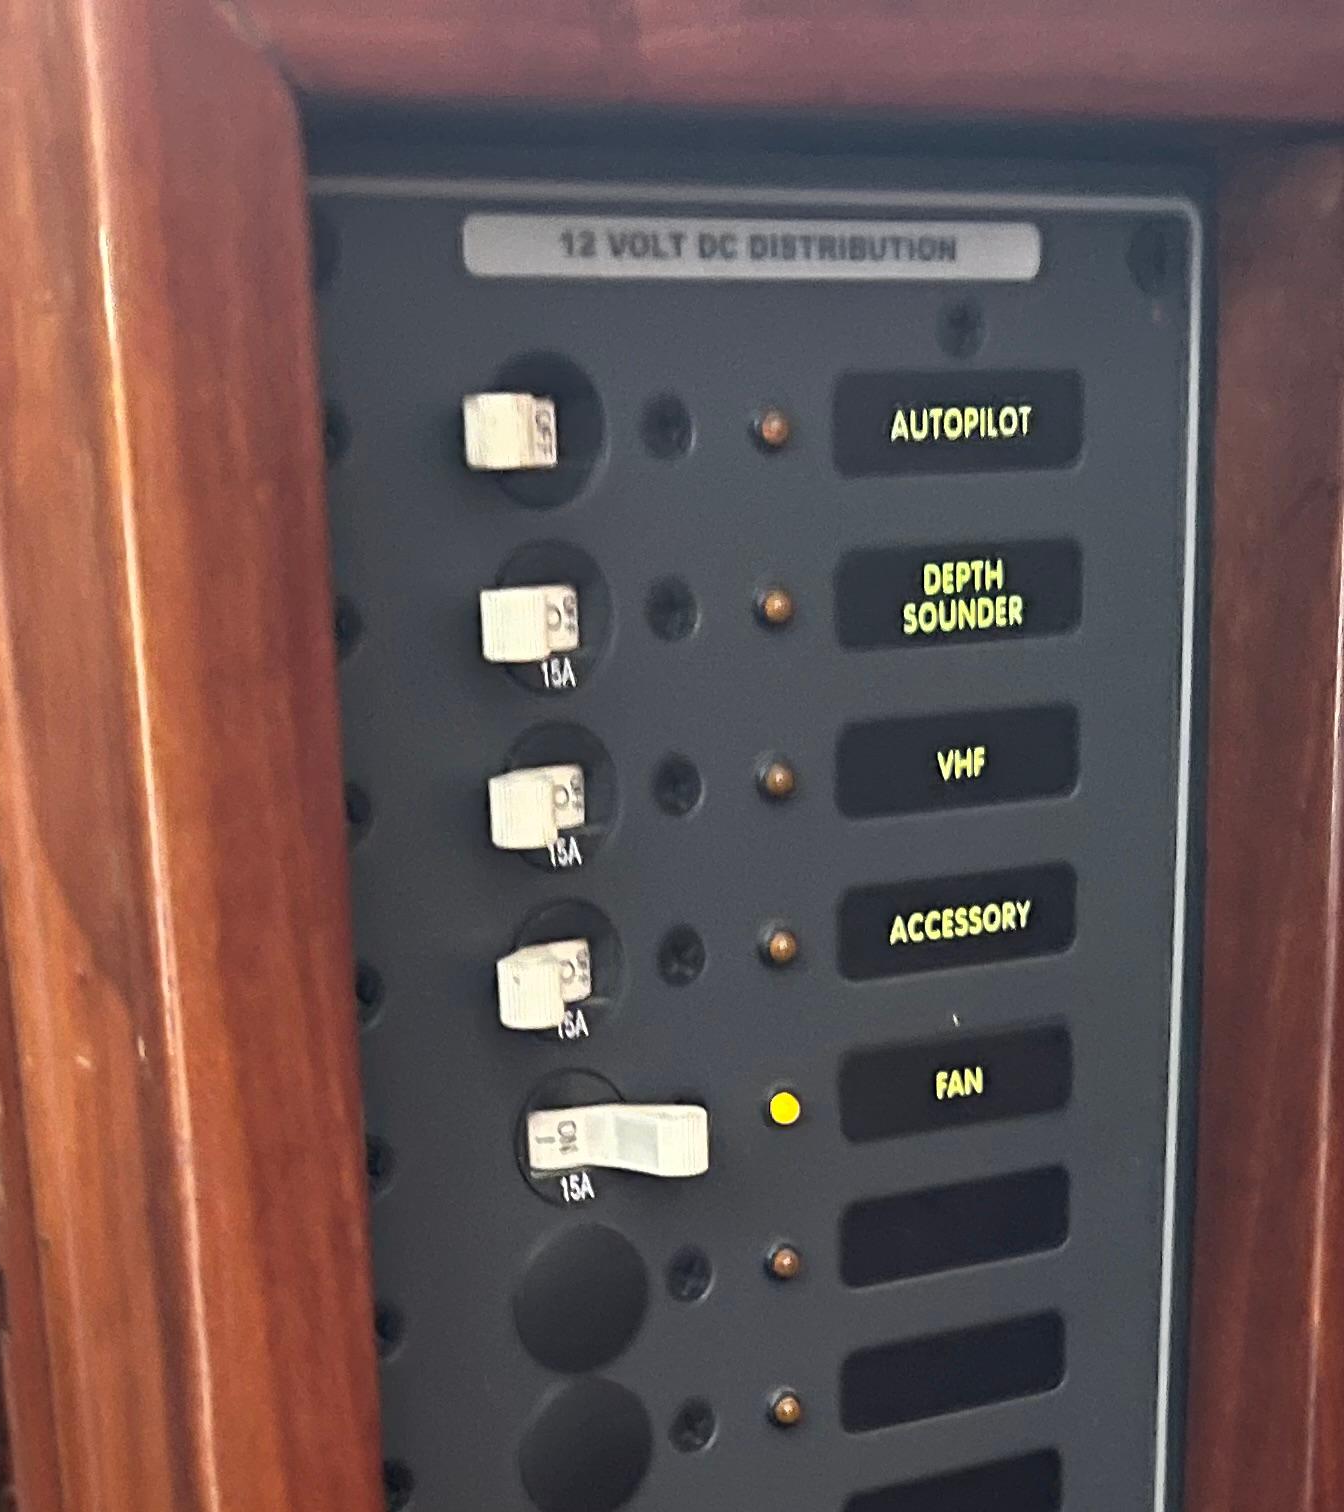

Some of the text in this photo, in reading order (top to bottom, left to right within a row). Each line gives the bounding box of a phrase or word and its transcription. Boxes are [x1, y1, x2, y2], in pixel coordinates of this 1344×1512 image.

[560, 229, 957, 262] 12 VOLT DC DISTRIBUTION
[890, 405, 1032, 442] AUTOPILOT
[923, 558, 1004, 596] DEPTH
[903, 595, 1023, 635] SOUNDER
[540, 656, 577, 688] 15A
[937, 745, 986, 782] VHF
[889, 899, 1031, 946] ACCESSORY
[935, 1066, 984, 1101] FAN
[560, 1171, 596, 1202] 15A
